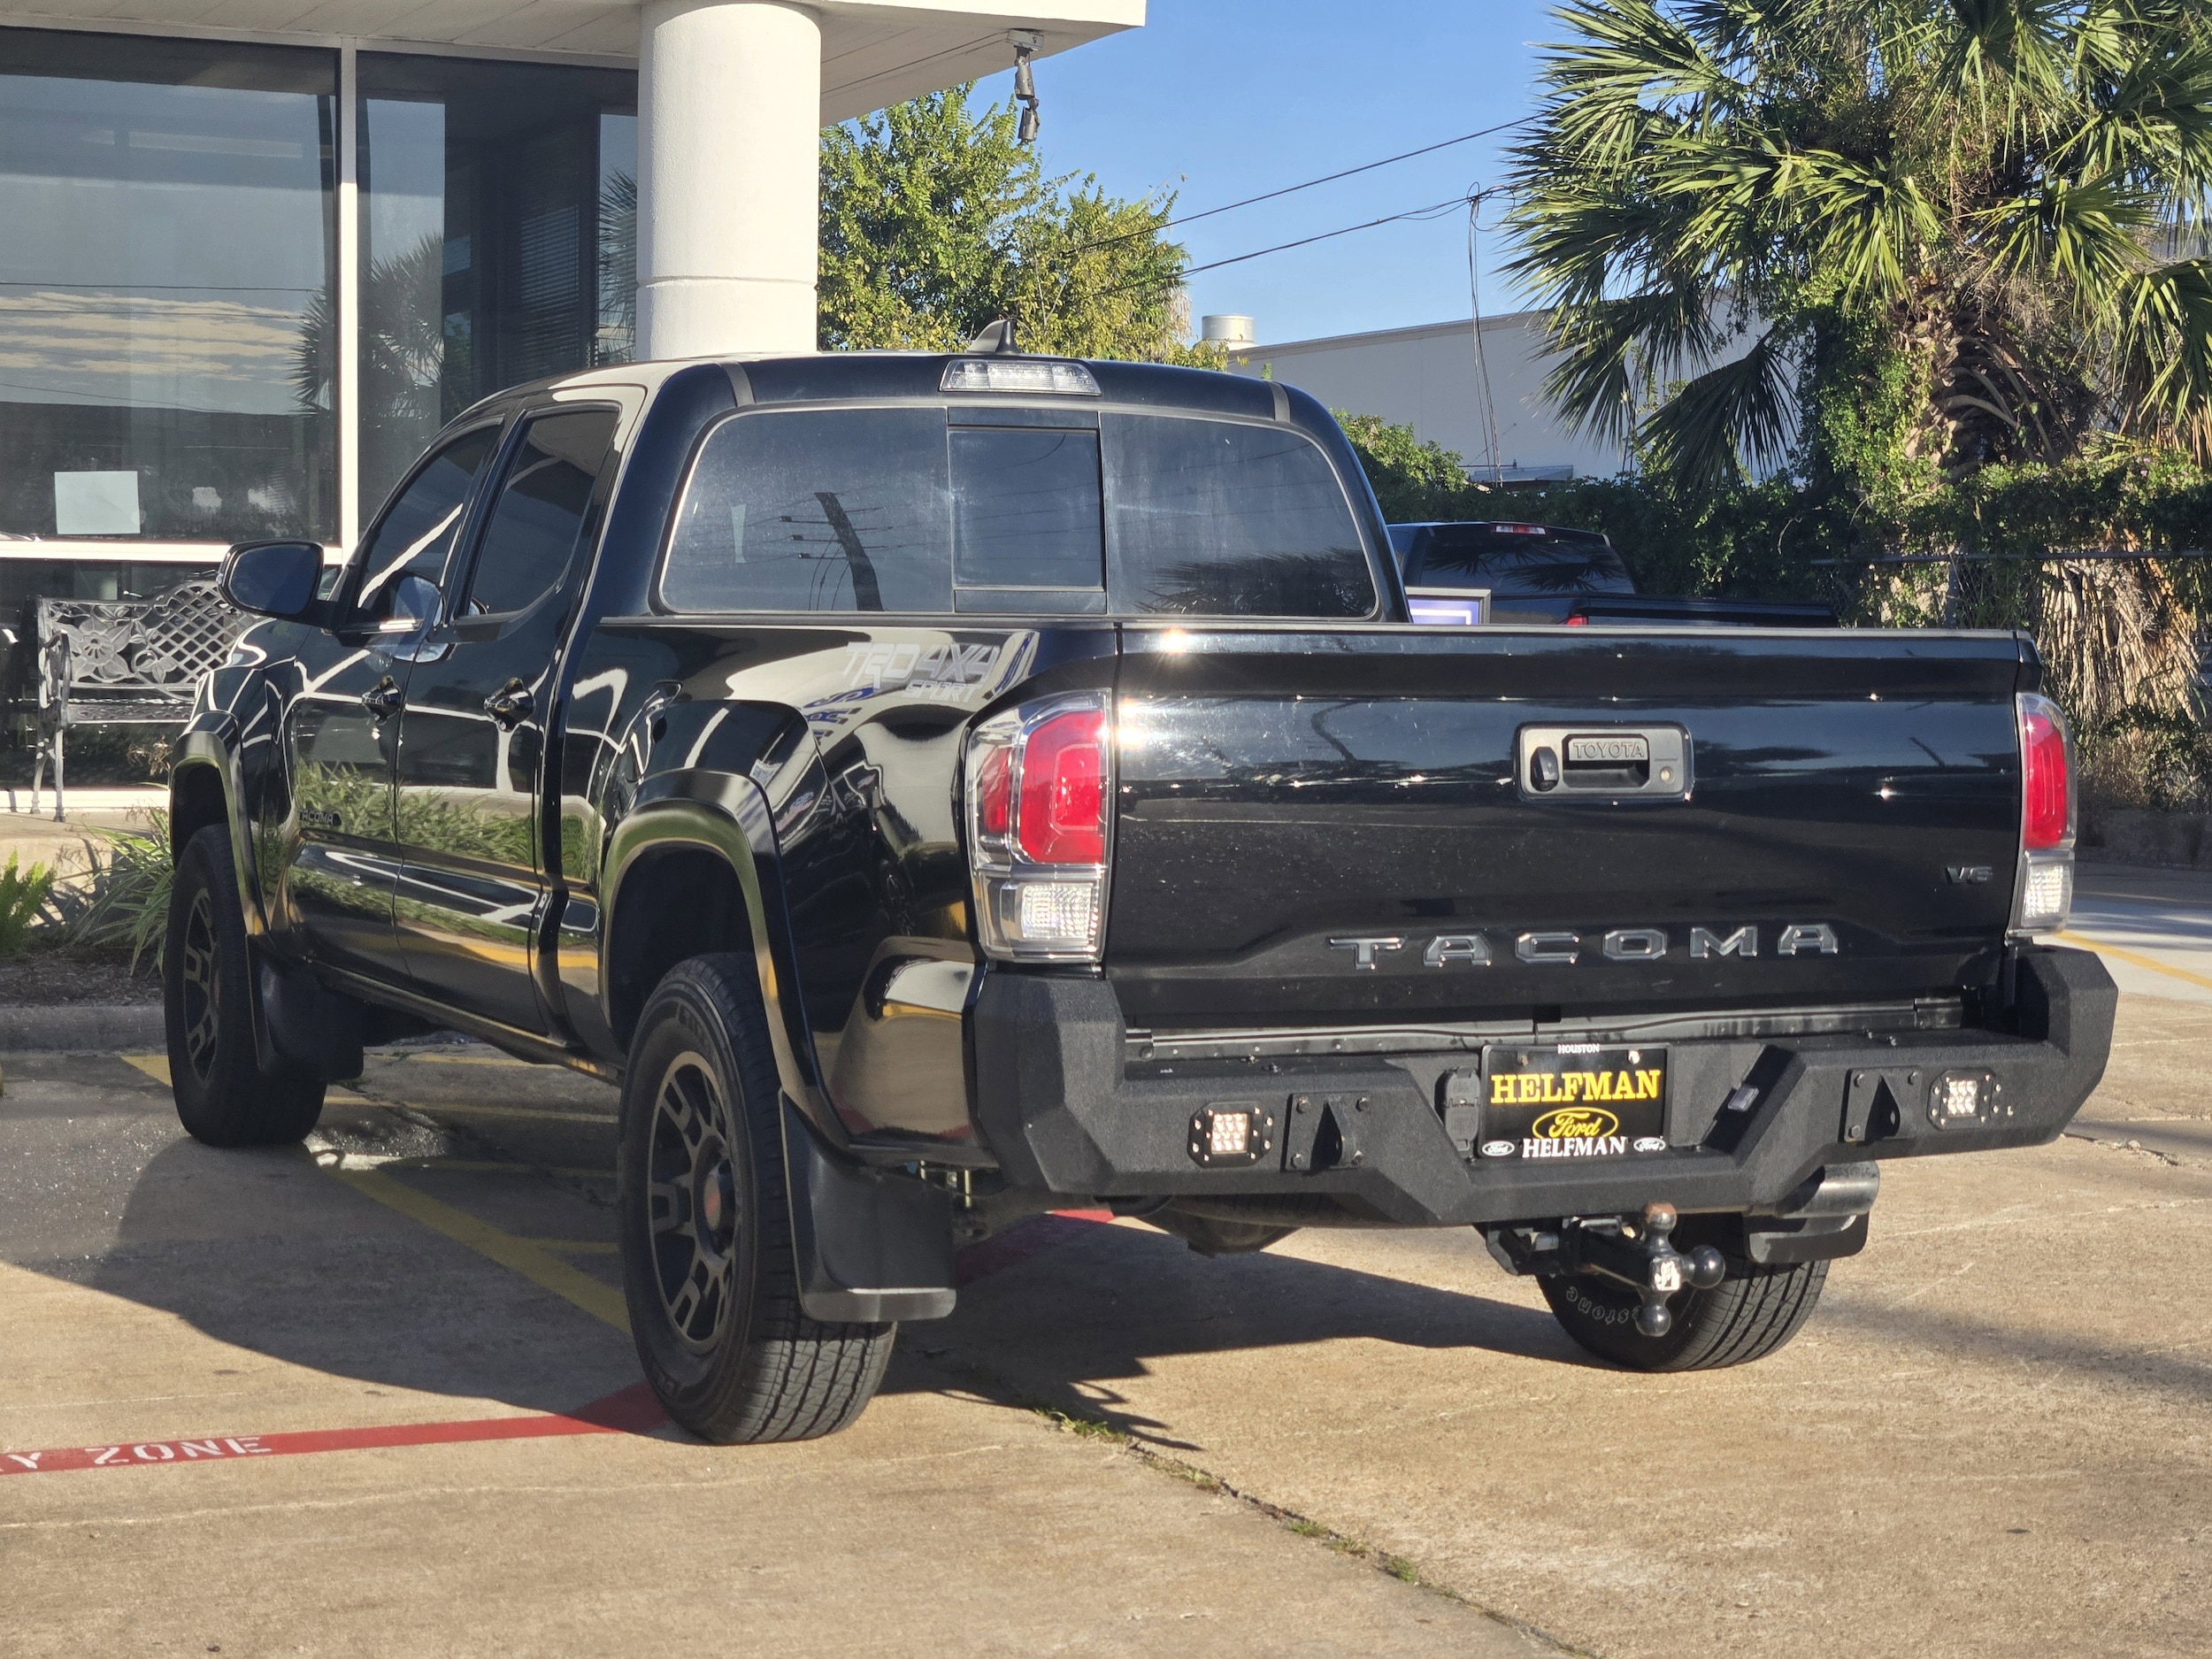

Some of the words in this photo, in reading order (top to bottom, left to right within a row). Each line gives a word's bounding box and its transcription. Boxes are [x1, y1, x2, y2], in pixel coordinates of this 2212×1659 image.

[842, 641, 920, 690] TRD
[902, 680, 986, 703] SPORT
[1573, 741, 1645, 759] TOYOTA
[1947, 866, 1993, 883] V6
[1329, 923, 1839, 970] TACOMA
[1557, 1043, 1600, 1055] HOUSTON
[1490, 1069, 1661, 1103] HELFMAN
[1548, 1111, 1603, 1138] Ford
[1522, 1136, 1628, 1157] HELFMAN
[85, 1437, 272, 1464] ZONE
